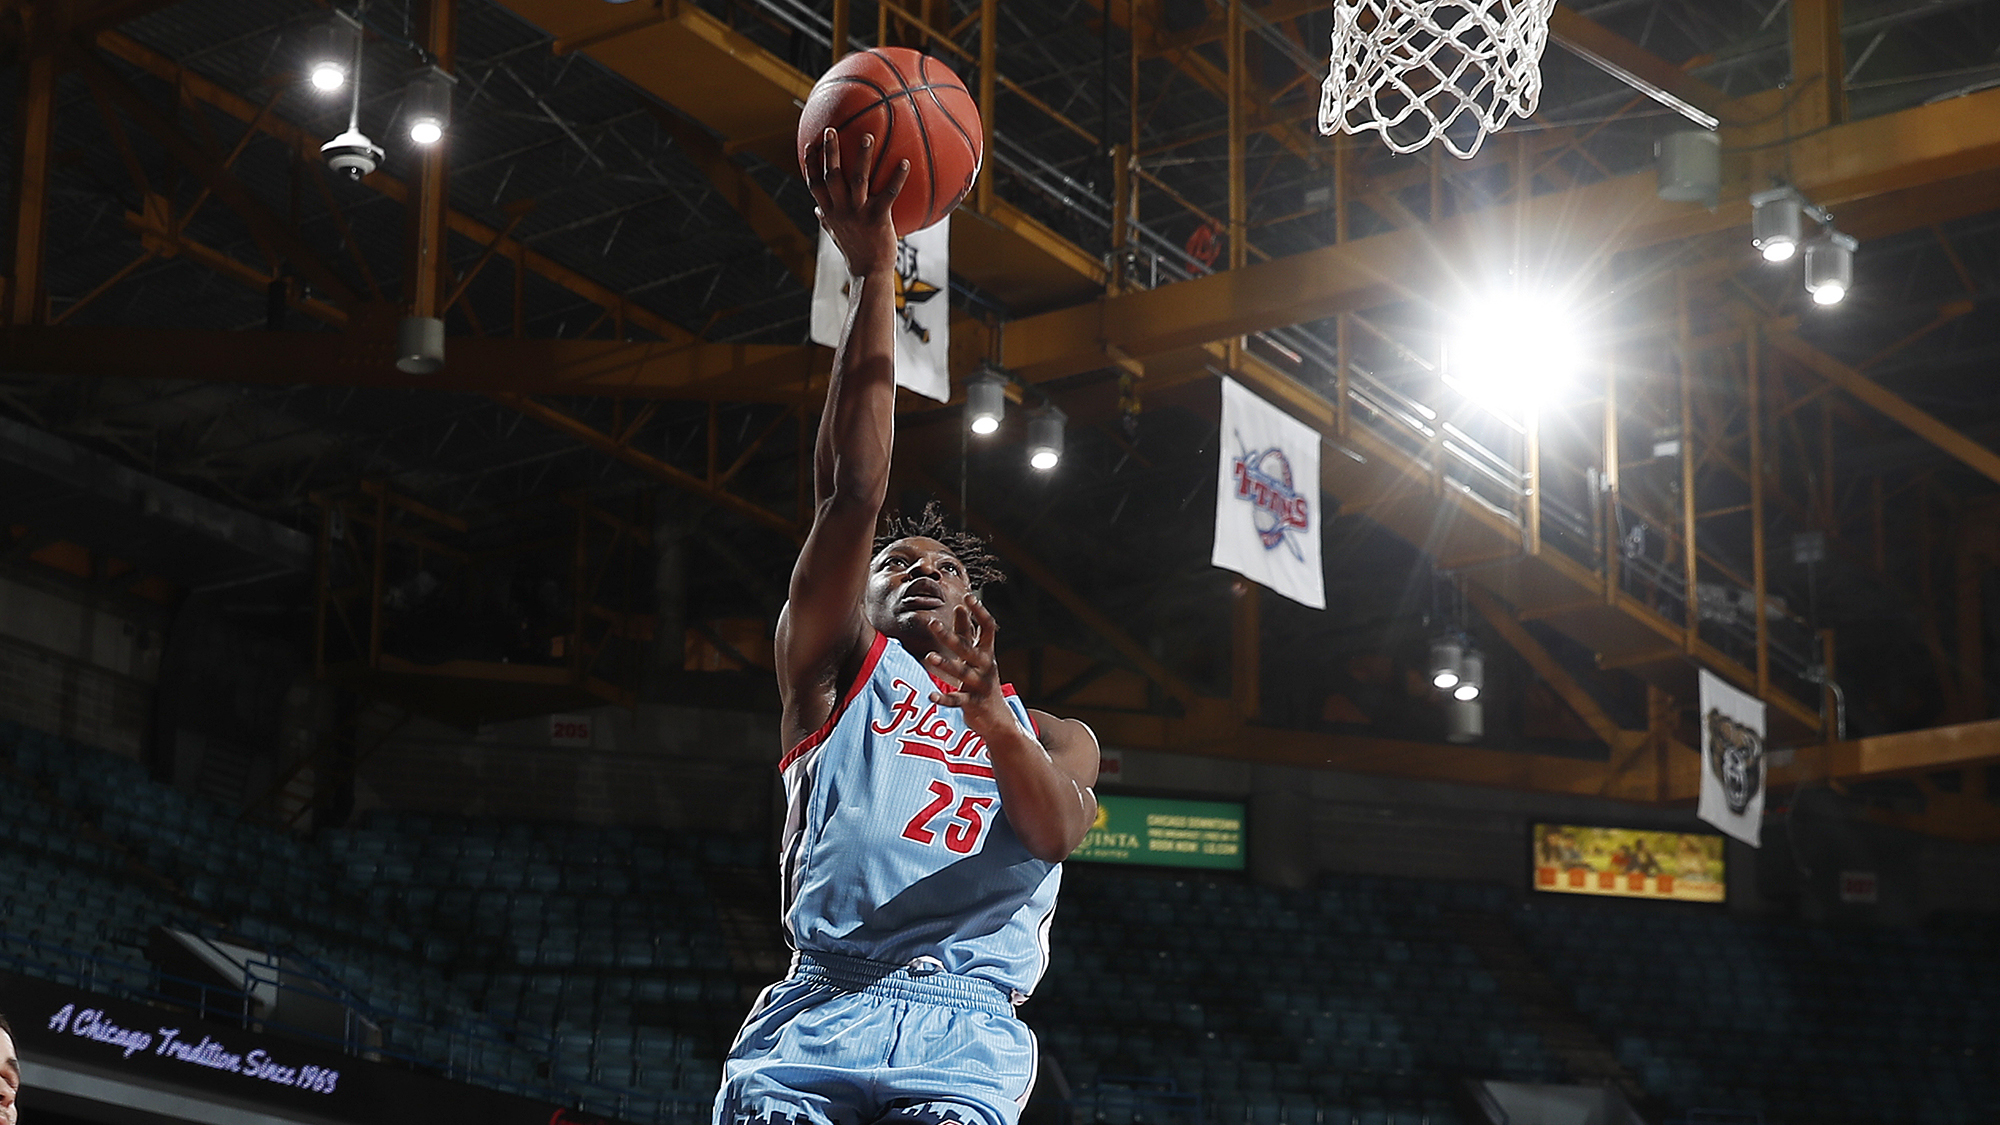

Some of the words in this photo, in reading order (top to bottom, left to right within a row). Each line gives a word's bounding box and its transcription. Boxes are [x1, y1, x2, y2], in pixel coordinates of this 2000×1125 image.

[554, 722, 588, 738] 205
[871, 678, 992, 759] Flam
[901, 778, 994, 855] 25
[1079, 831, 1140, 849] UINTA
[48, 1002, 76, 1034] A
[71, 1008, 153, 1059] Chicago
[155, 1026, 242, 1073] Tradition
[241, 1048, 297, 1086] Since
[294, 1064, 341, 1095] 1963
